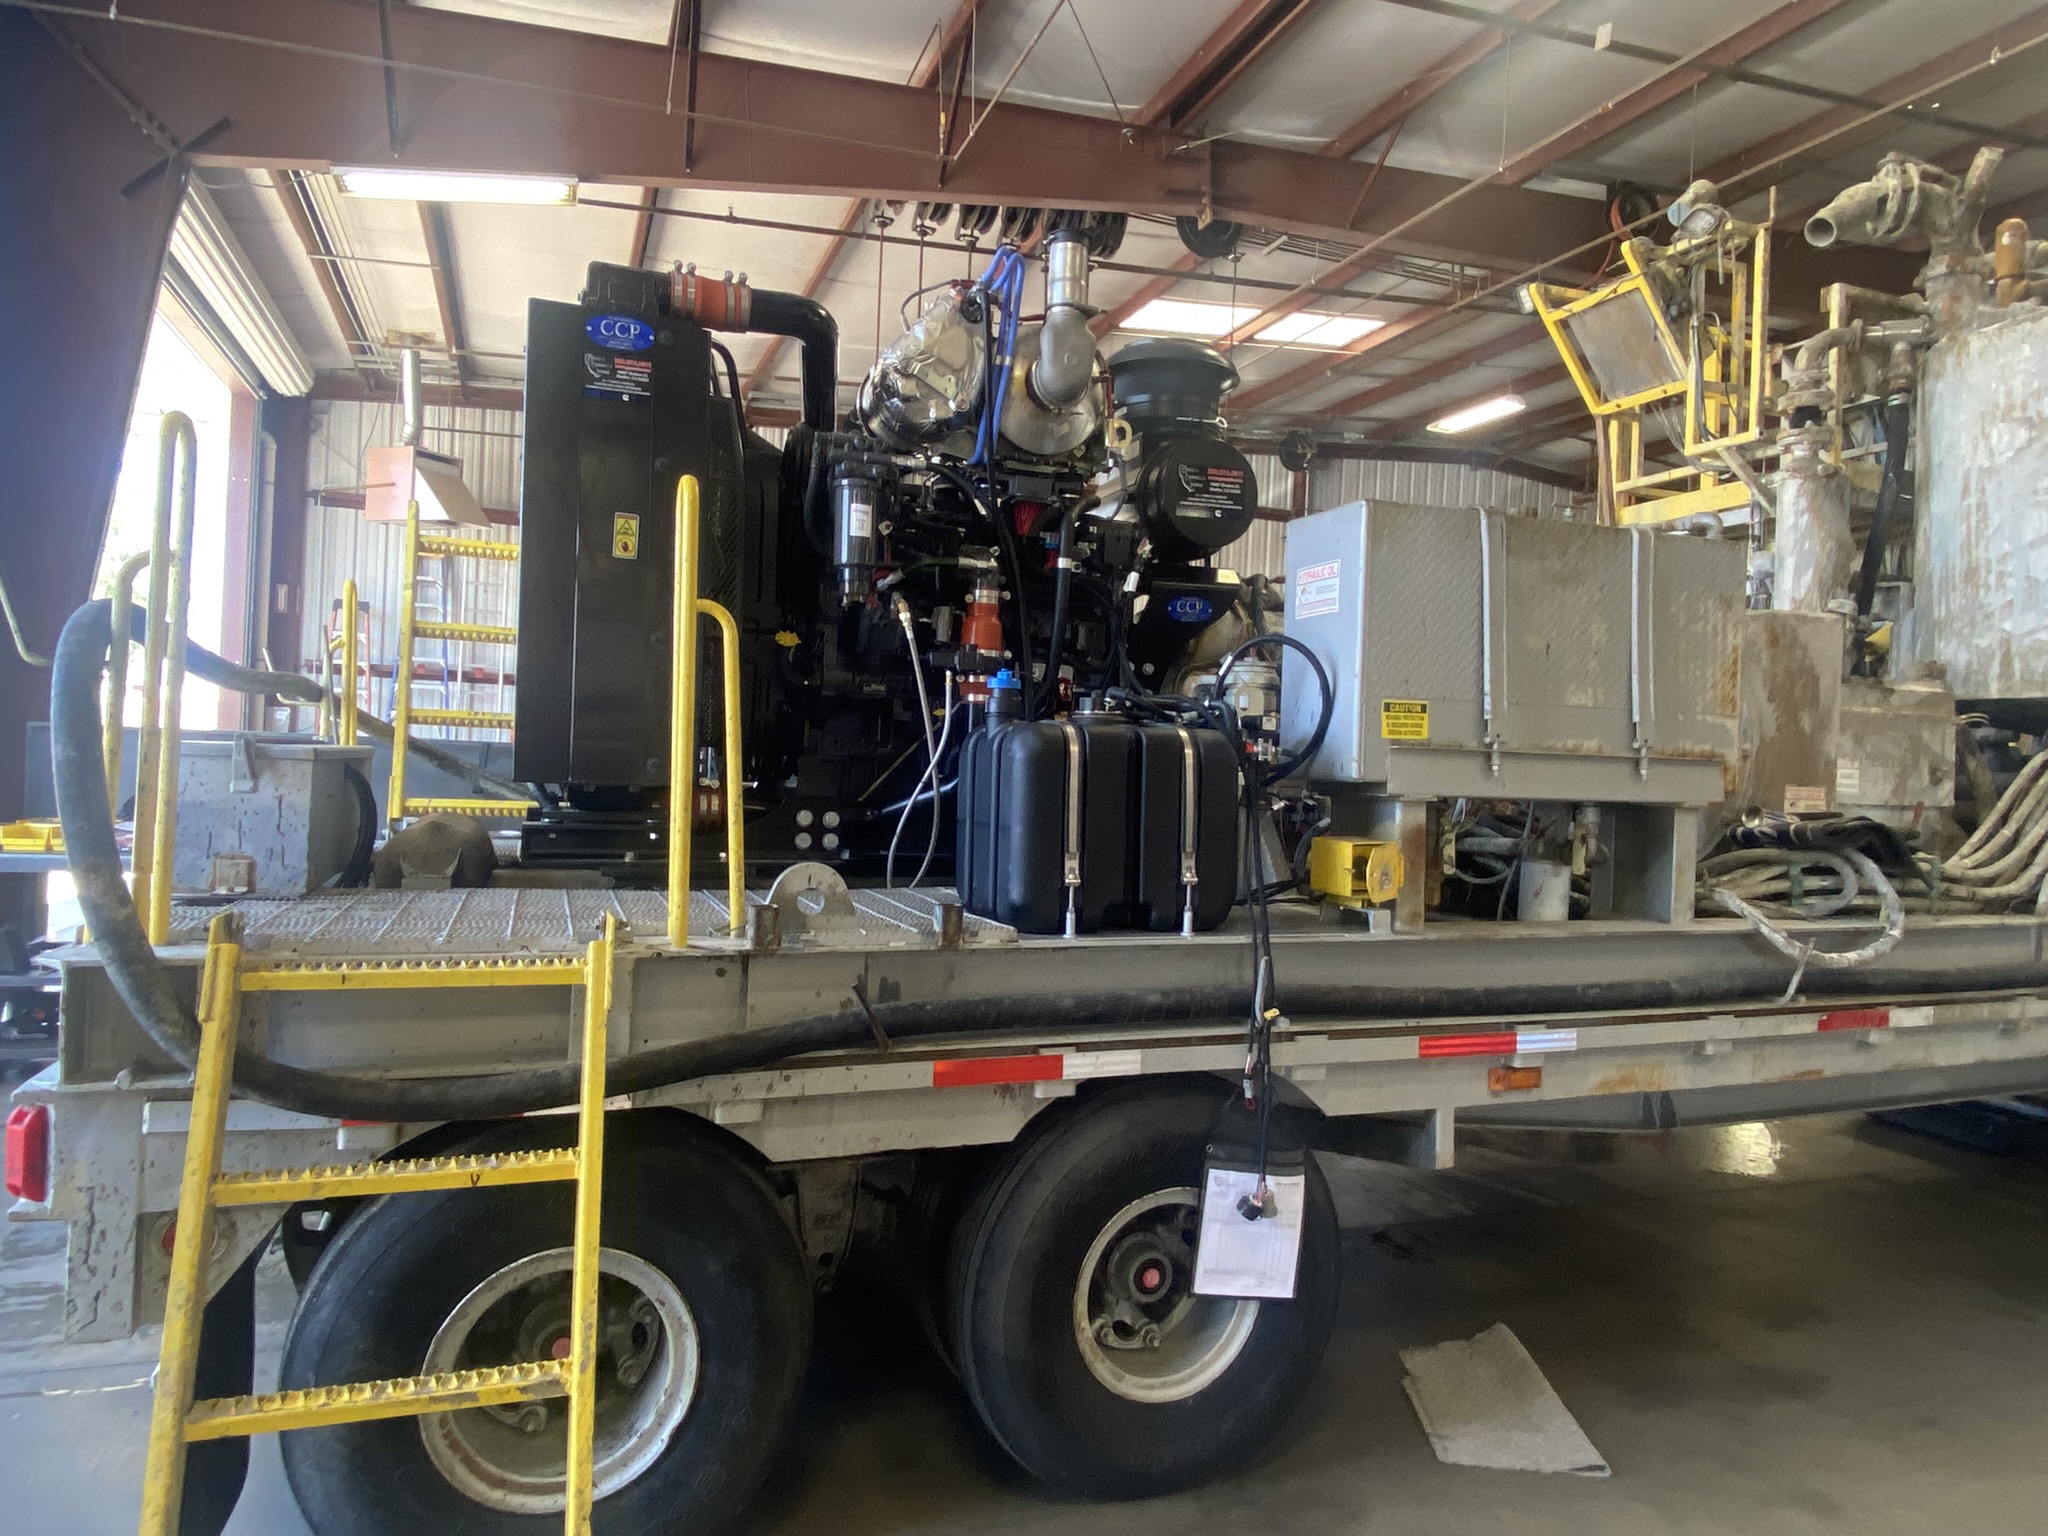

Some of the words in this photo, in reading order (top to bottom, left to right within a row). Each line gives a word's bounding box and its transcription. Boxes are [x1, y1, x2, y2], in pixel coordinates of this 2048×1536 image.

[600, 319, 641, 339] CCP
[1176, 600, 1203, 613] CCP
[1390, 703, 1422, 713] CAUTION
